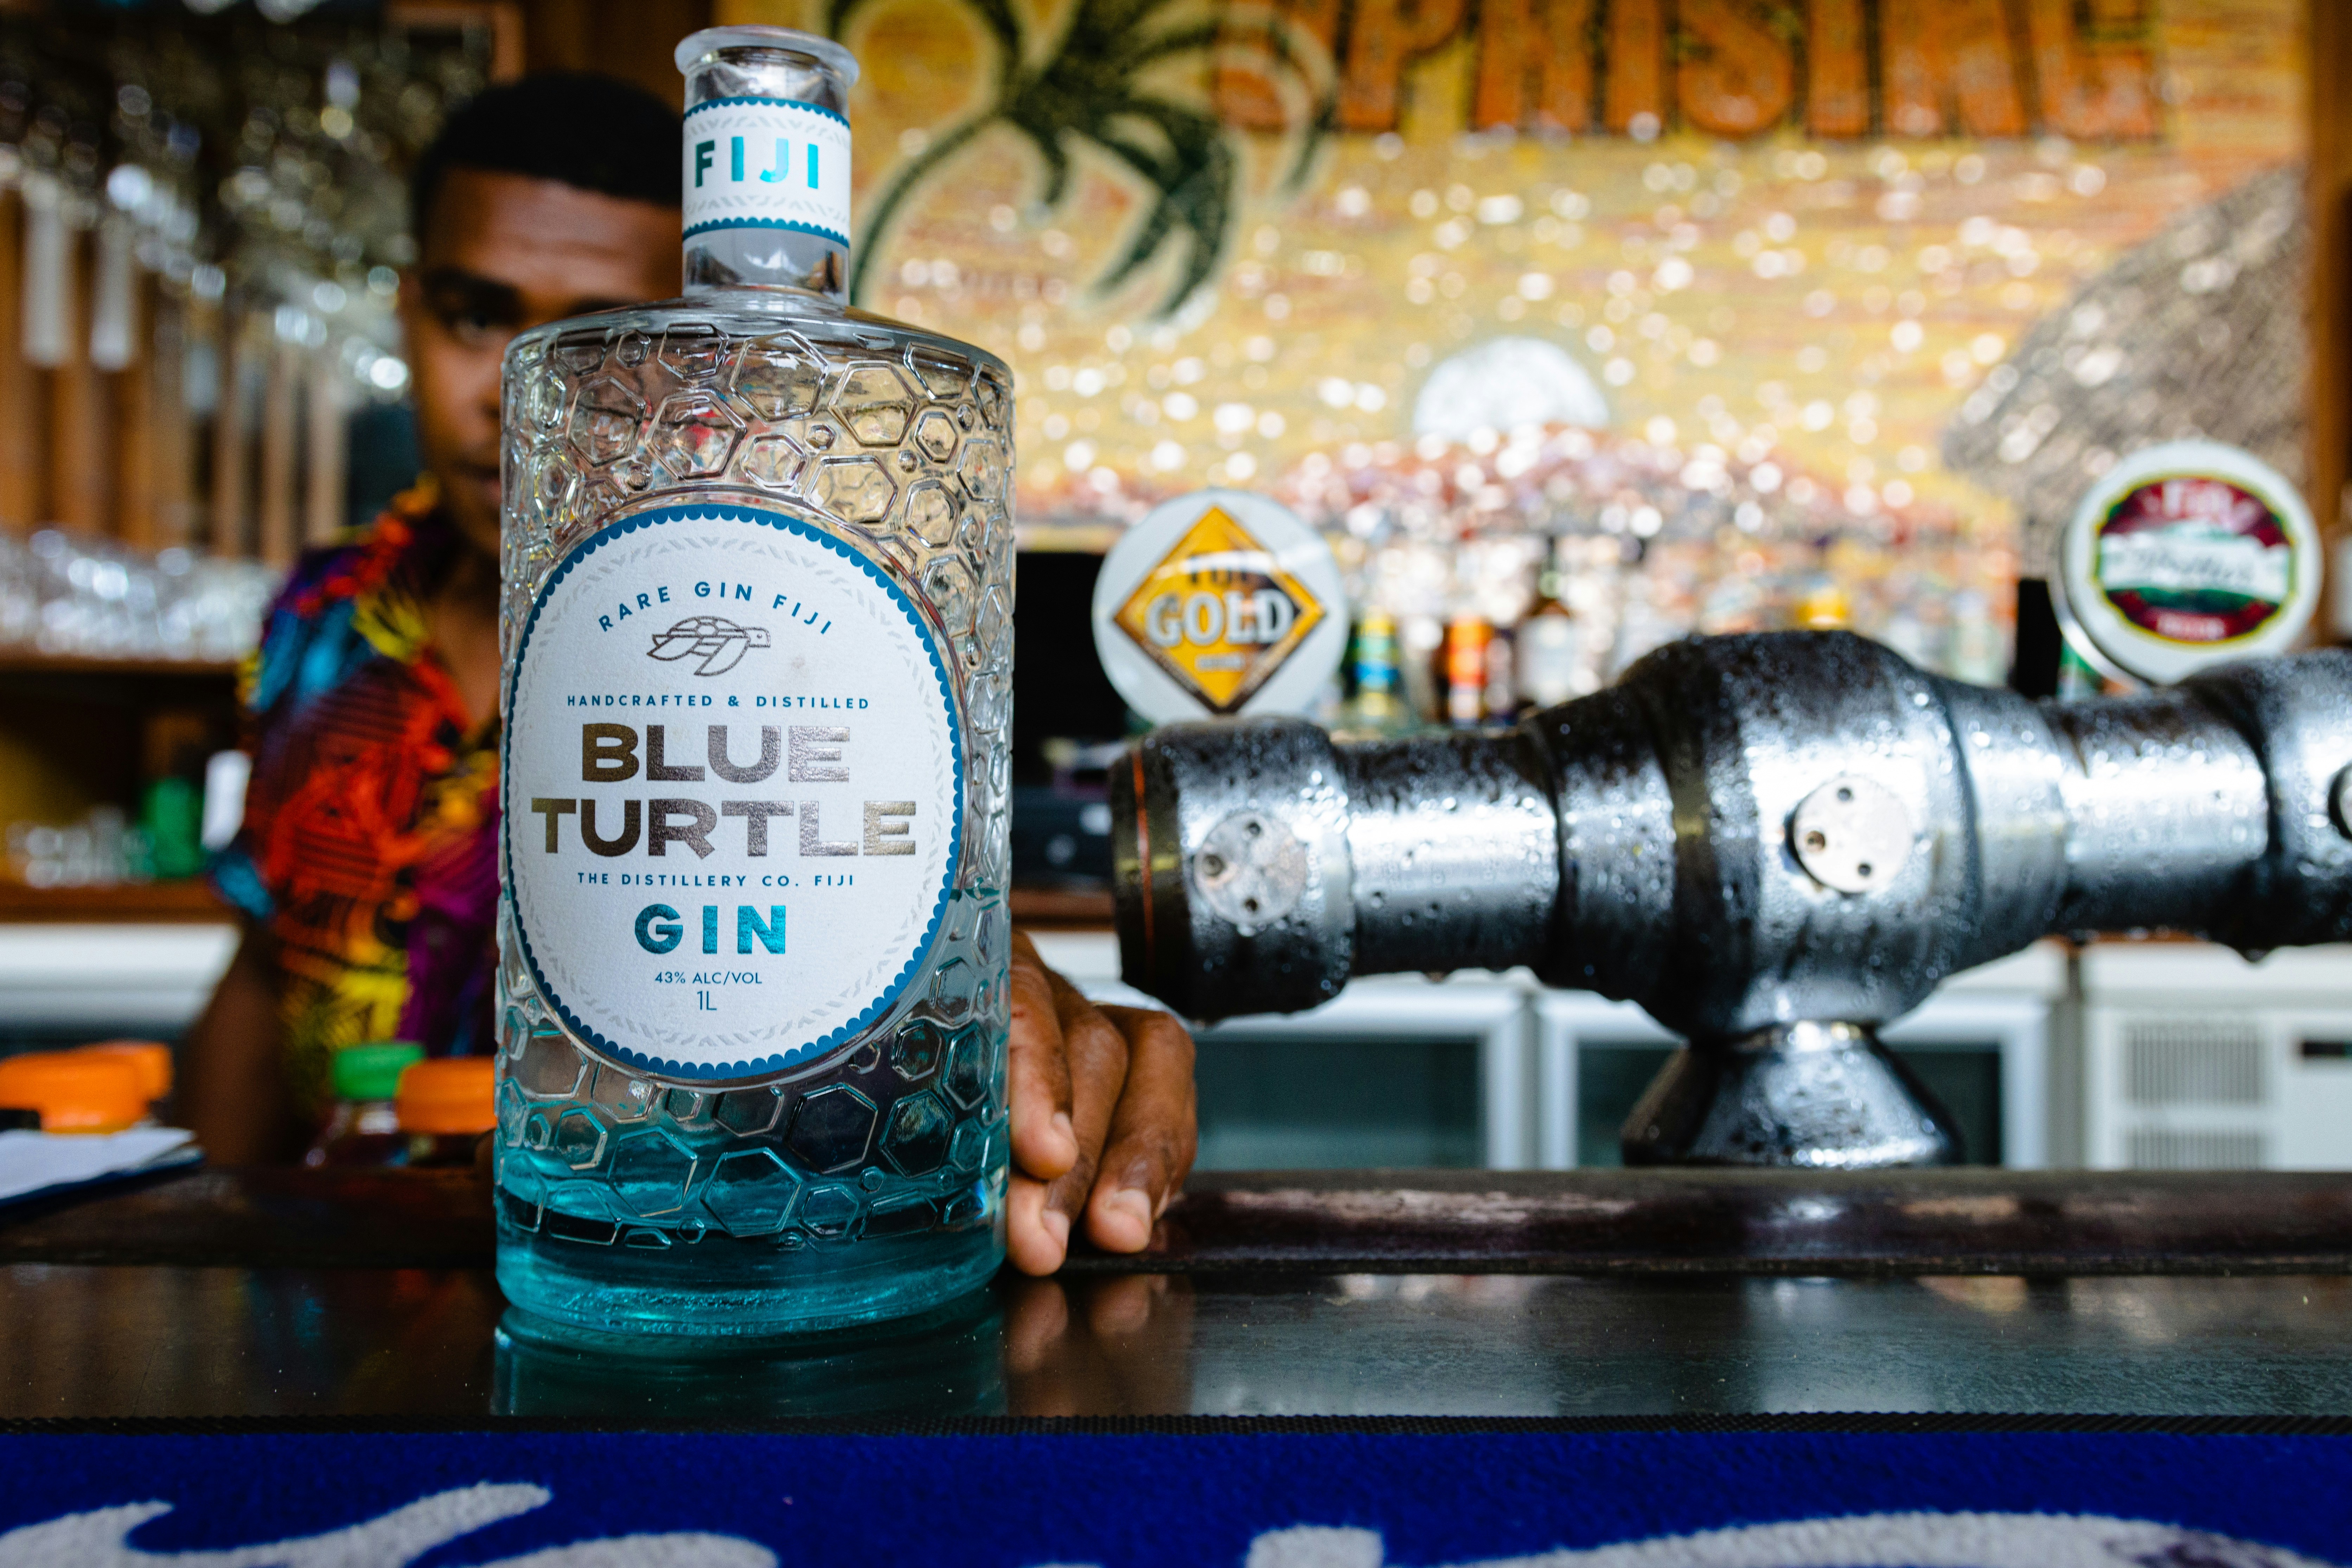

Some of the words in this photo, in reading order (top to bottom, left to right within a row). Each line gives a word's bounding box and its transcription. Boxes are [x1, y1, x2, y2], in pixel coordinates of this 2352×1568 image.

[695, 136, 819, 190] FIJI
[598, 586, 670, 632] RARE
[694, 581, 752, 601] GIN
[773, 594, 832, 635] FIJI
[1144, 588, 1294, 647] GOLD
[567, 695, 712, 706] HANDCRAFTED
[728, 696, 739, 707] &
[756, 697, 869, 710] DISTILLED
[582, 723, 850, 783] BLUE
[531, 798, 916, 860] TURTLE
[578, 872, 609, 884] THE
[622, 874, 747, 887] DISTILLERY
[762, 875, 798, 887] CO.
[814, 875, 854, 887] FIJI
[634, 903, 786, 955] GIN
[655, 971, 685, 984] 43%
[692, 971, 762, 985] ALC/VOL
[697, 990, 717, 1011] 1L
